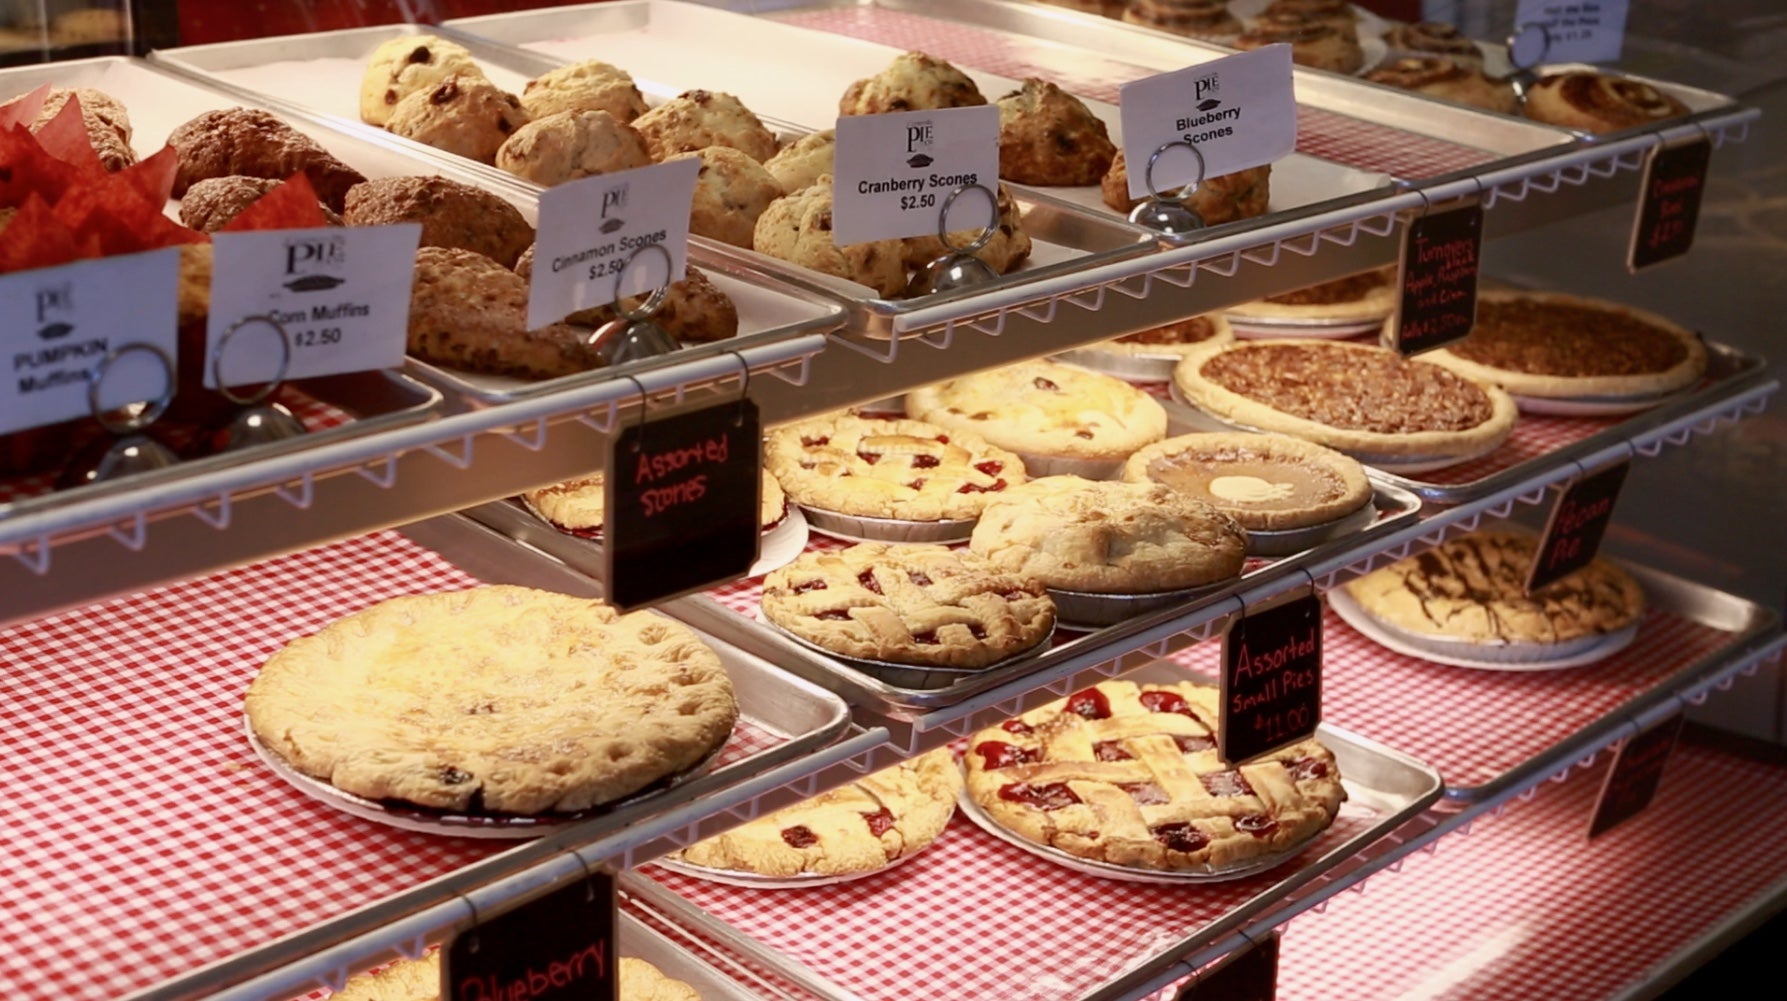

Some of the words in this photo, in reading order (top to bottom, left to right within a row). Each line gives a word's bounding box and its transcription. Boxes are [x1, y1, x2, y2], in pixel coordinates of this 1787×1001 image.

[1175, 105, 1242, 132] Blueberry
[906, 125, 935, 153] PIE
[1183, 124, 1235, 146] Scones
[857, 176, 926, 195] Cranberry
[928, 172, 978, 189] Scones
[900, 193, 937, 211] $2.50
[551, 242, 616, 274] Cinnamon
[618, 228, 668, 252] Scones
[588, 257, 626, 281] $2.50
[270, 308, 307, 326] Corn
[311, 302, 370, 322] Muffins
[294, 327, 343, 347] $2.50
[13, 337, 108, 373] PUMPKIN
[18, 368, 93, 395] Muffins
[634, 432, 730, 486] Assorted
[1233, 626, 1316, 689] Assorted
[1282, 669, 1315, 698] Pies
